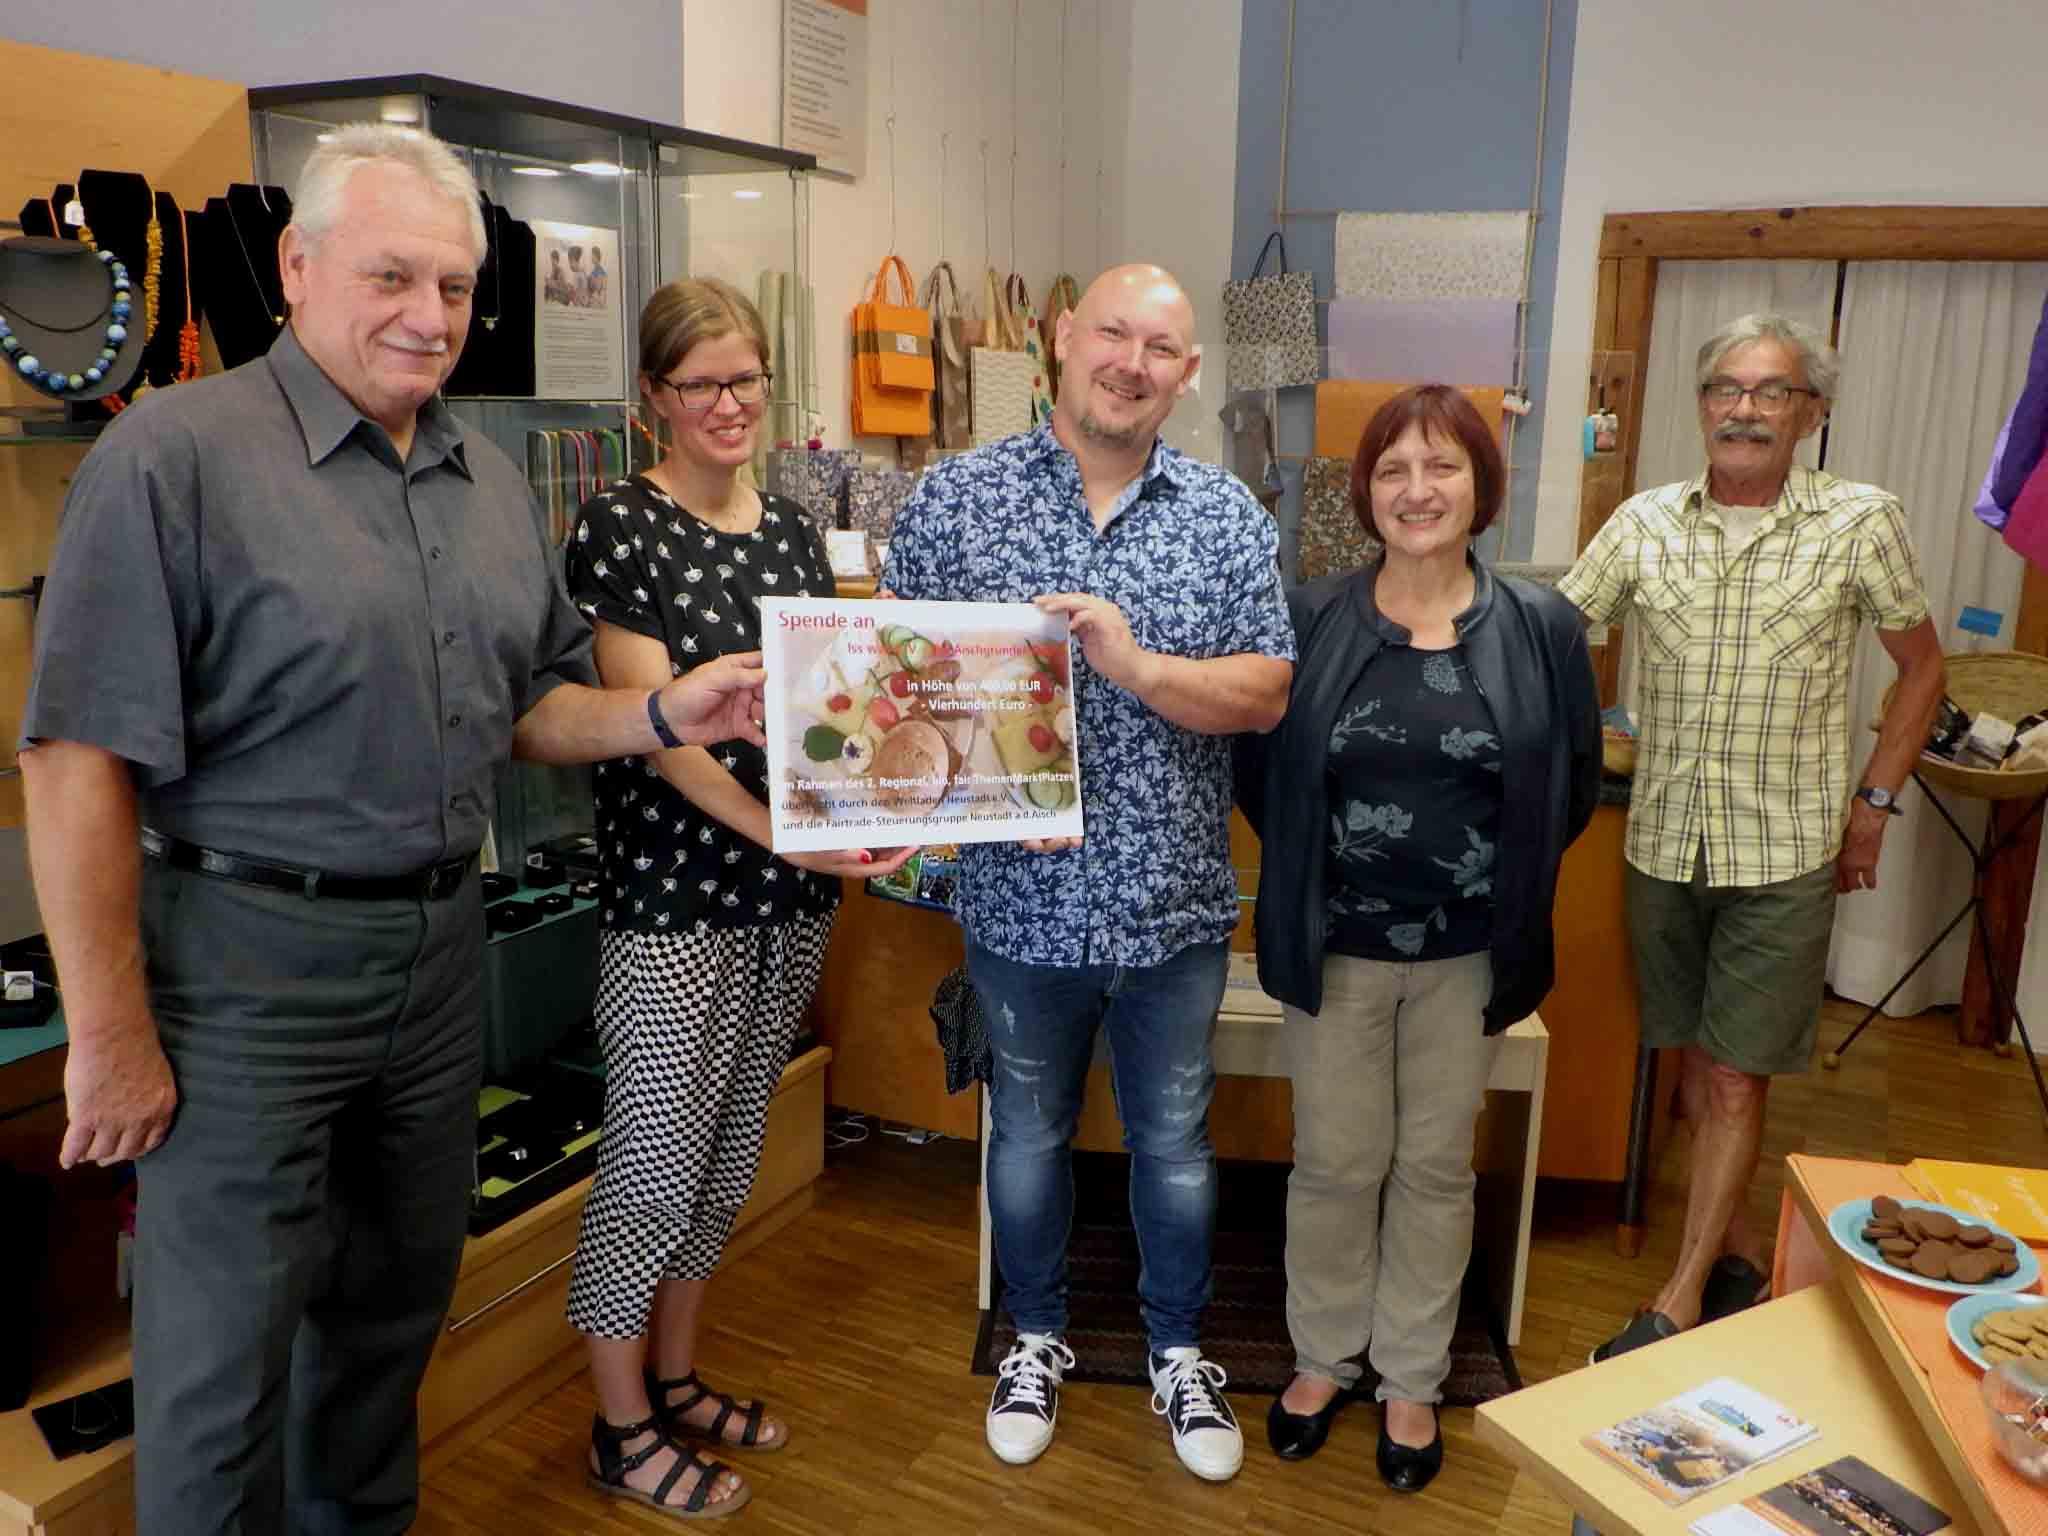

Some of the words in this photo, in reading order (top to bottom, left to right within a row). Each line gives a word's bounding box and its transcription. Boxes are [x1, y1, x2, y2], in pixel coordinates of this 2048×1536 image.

[778, 610, 847, 631] Spende
[853, 615, 875, 629] an
[922, 679, 953, 692] Höhe
[1020, 679, 1041, 692] EUR
[928, 698, 996, 712] Vierhundert
[1001, 698, 1025, 711] Euro
[838, 797, 868, 810] durch
[946, 790, 990, 804] Neustadt
[783, 819, 804, 831] und
[806, 818, 821, 829] die
[826, 814, 968, 830] Fairtrade-Steuerungsgruppe
[970, 810, 1013, 822] Neustadt
